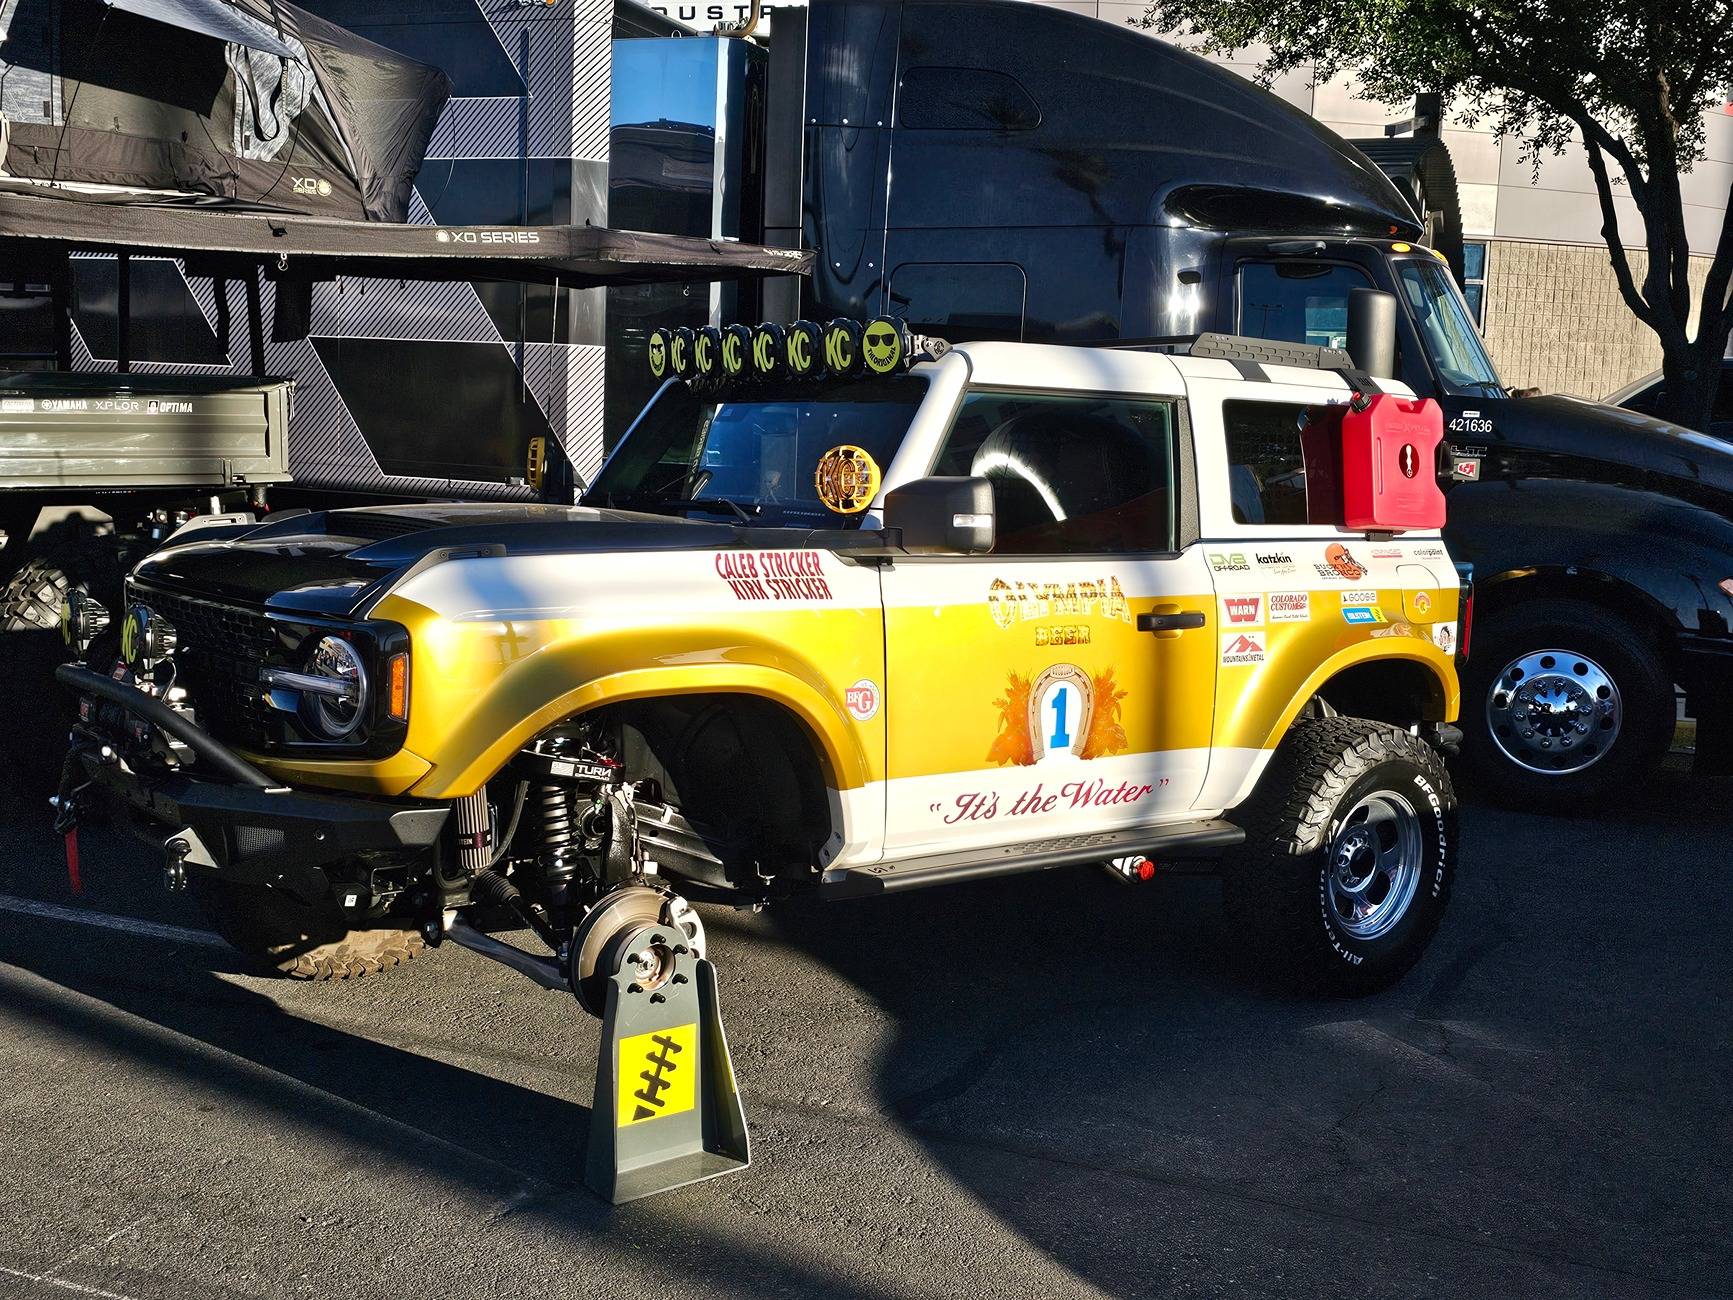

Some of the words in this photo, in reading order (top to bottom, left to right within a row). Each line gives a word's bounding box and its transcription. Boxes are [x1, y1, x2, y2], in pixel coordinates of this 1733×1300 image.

[451, 231, 477, 243] XO
[480, 231, 540, 244] SERIES
[671, 335, 686, 373] KC
[695, 334, 713, 373] KC
[722, 333, 742, 373] KC
[753, 331, 775, 373] KC
[787, 329, 812, 372] KC
[825, 327, 851, 371] KC
[52, 400, 88, 410] YAMAHA
[95, 400, 139, 411] XPLOR
[160, 402, 193, 413] OPTIMA
[1449, 419, 1493, 433] 421636
[715, 553, 759, 580] CALEB
[759, 551, 825, 578] STRICKER
[1255, 552, 1293, 565] katzkin
[727, 579, 770, 600] KIRK
[765, 577, 833, 600] STRICKER
[988, 576, 1133, 629] OLYMPIA
[1271, 594, 1308, 603] COLORADO
[1229, 604, 1255, 616] WARN
[121, 614, 138, 665] KC
[1035, 624, 1091, 647] BEER
[1050, 687, 1070, 749] 1
[1004, 783, 1058, 817] the
[1413, 774, 1447, 898] BFGoodrich
[1320, 869, 1364, 966] All-Terrain
